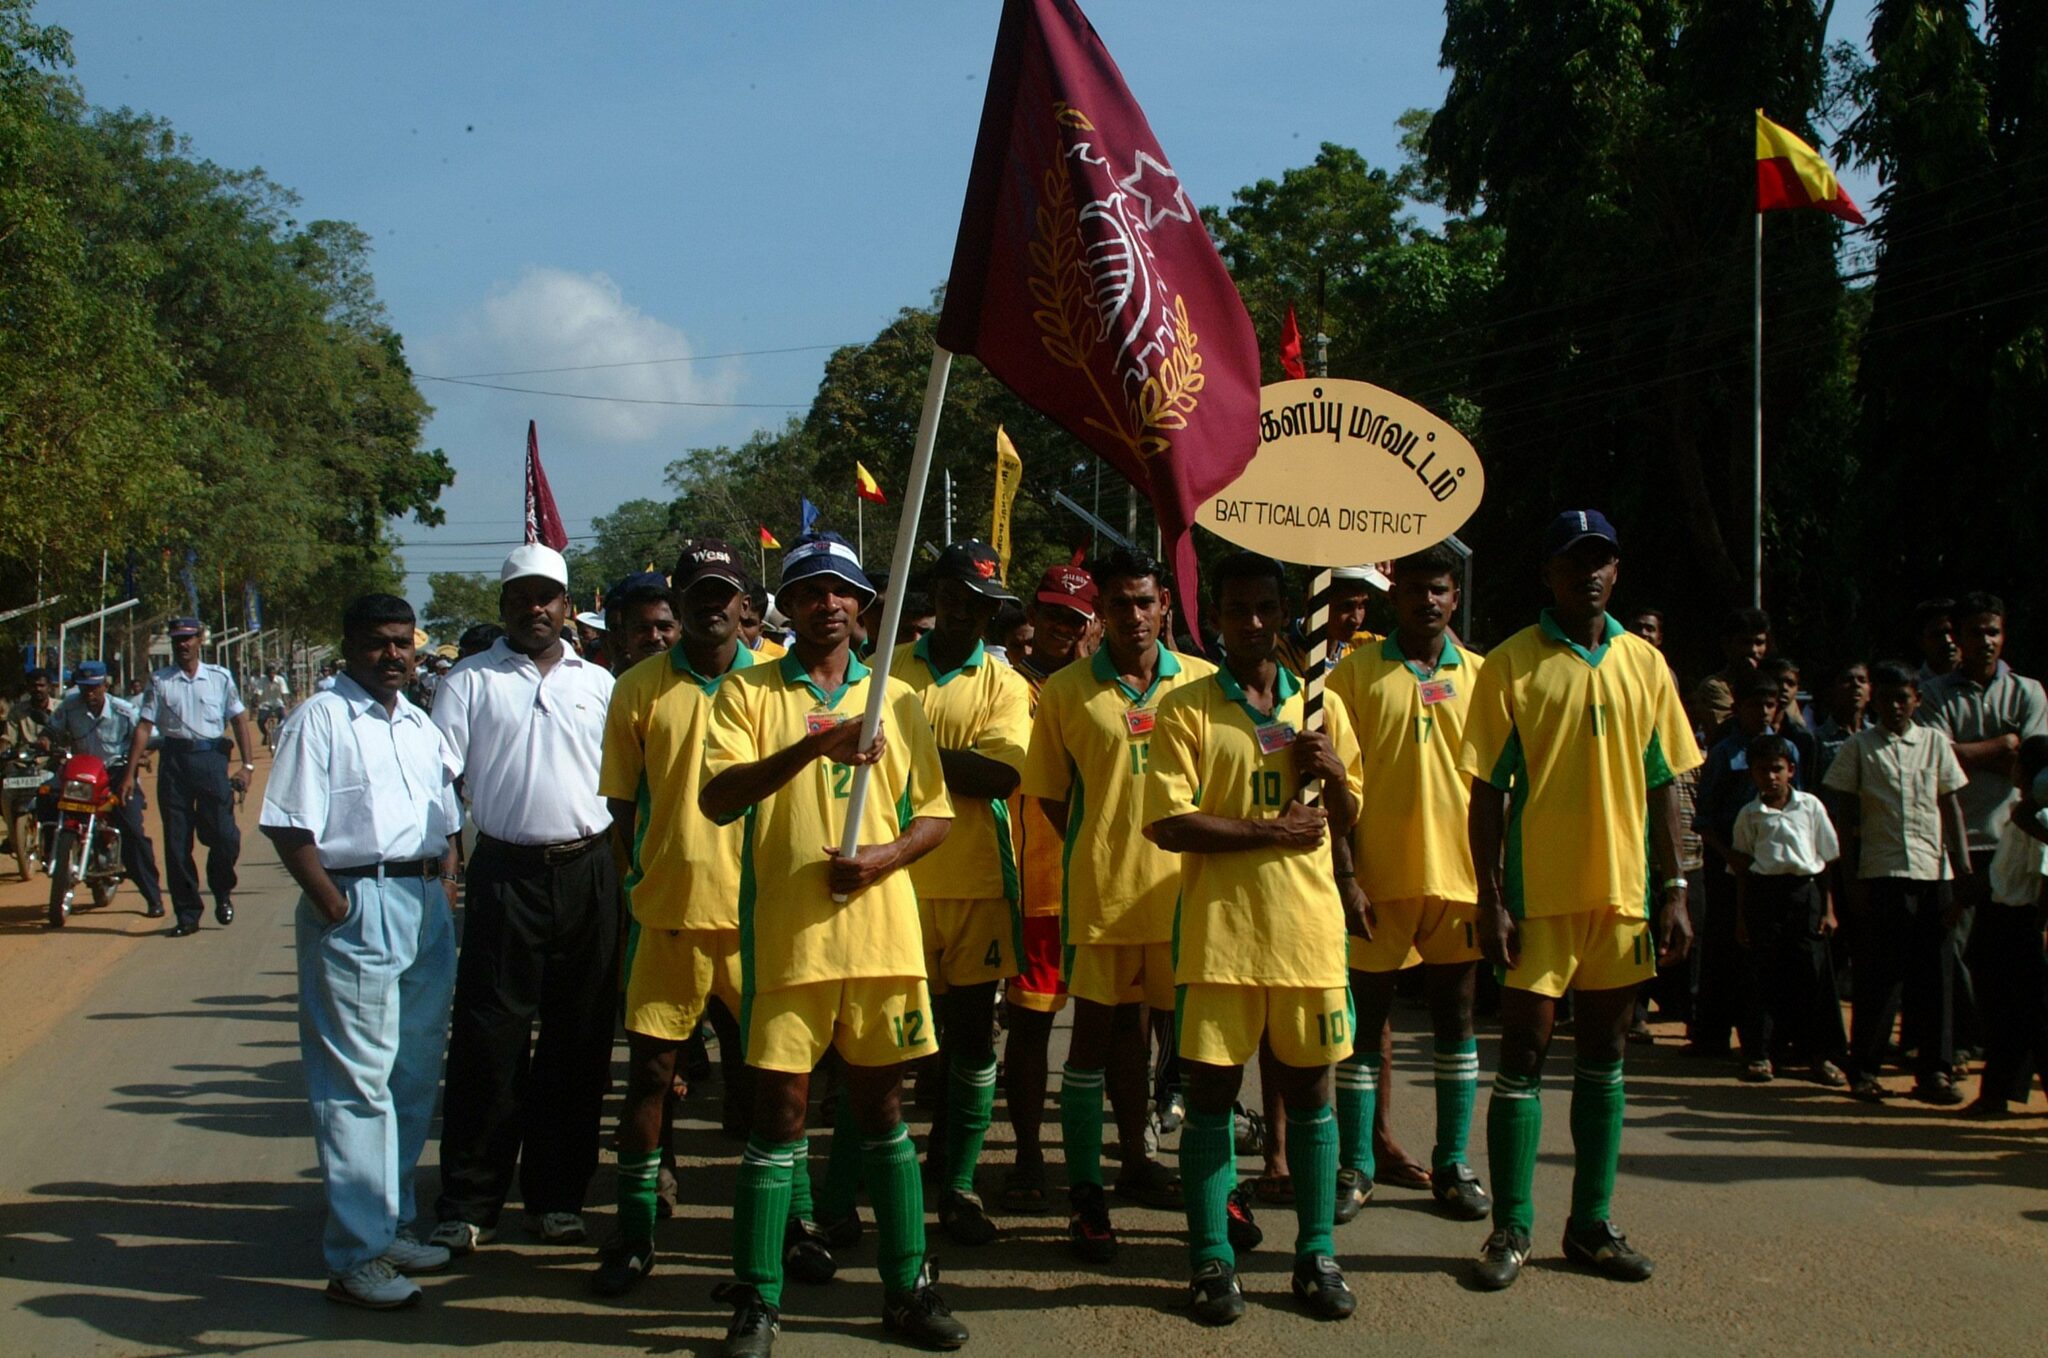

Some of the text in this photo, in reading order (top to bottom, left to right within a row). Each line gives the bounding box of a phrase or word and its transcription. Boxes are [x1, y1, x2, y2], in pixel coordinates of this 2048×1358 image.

[1258, 387, 1465, 502] களப்பு மாவட்டம்
[1215, 499, 1428, 535] BATTICALOA DISTRICT
[1251, 771, 1281, 806] 10
[984, 938, 1002, 969] 4
[893, 1008, 928, 1048] 12
[1316, 1009, 1345, 1046] 10
